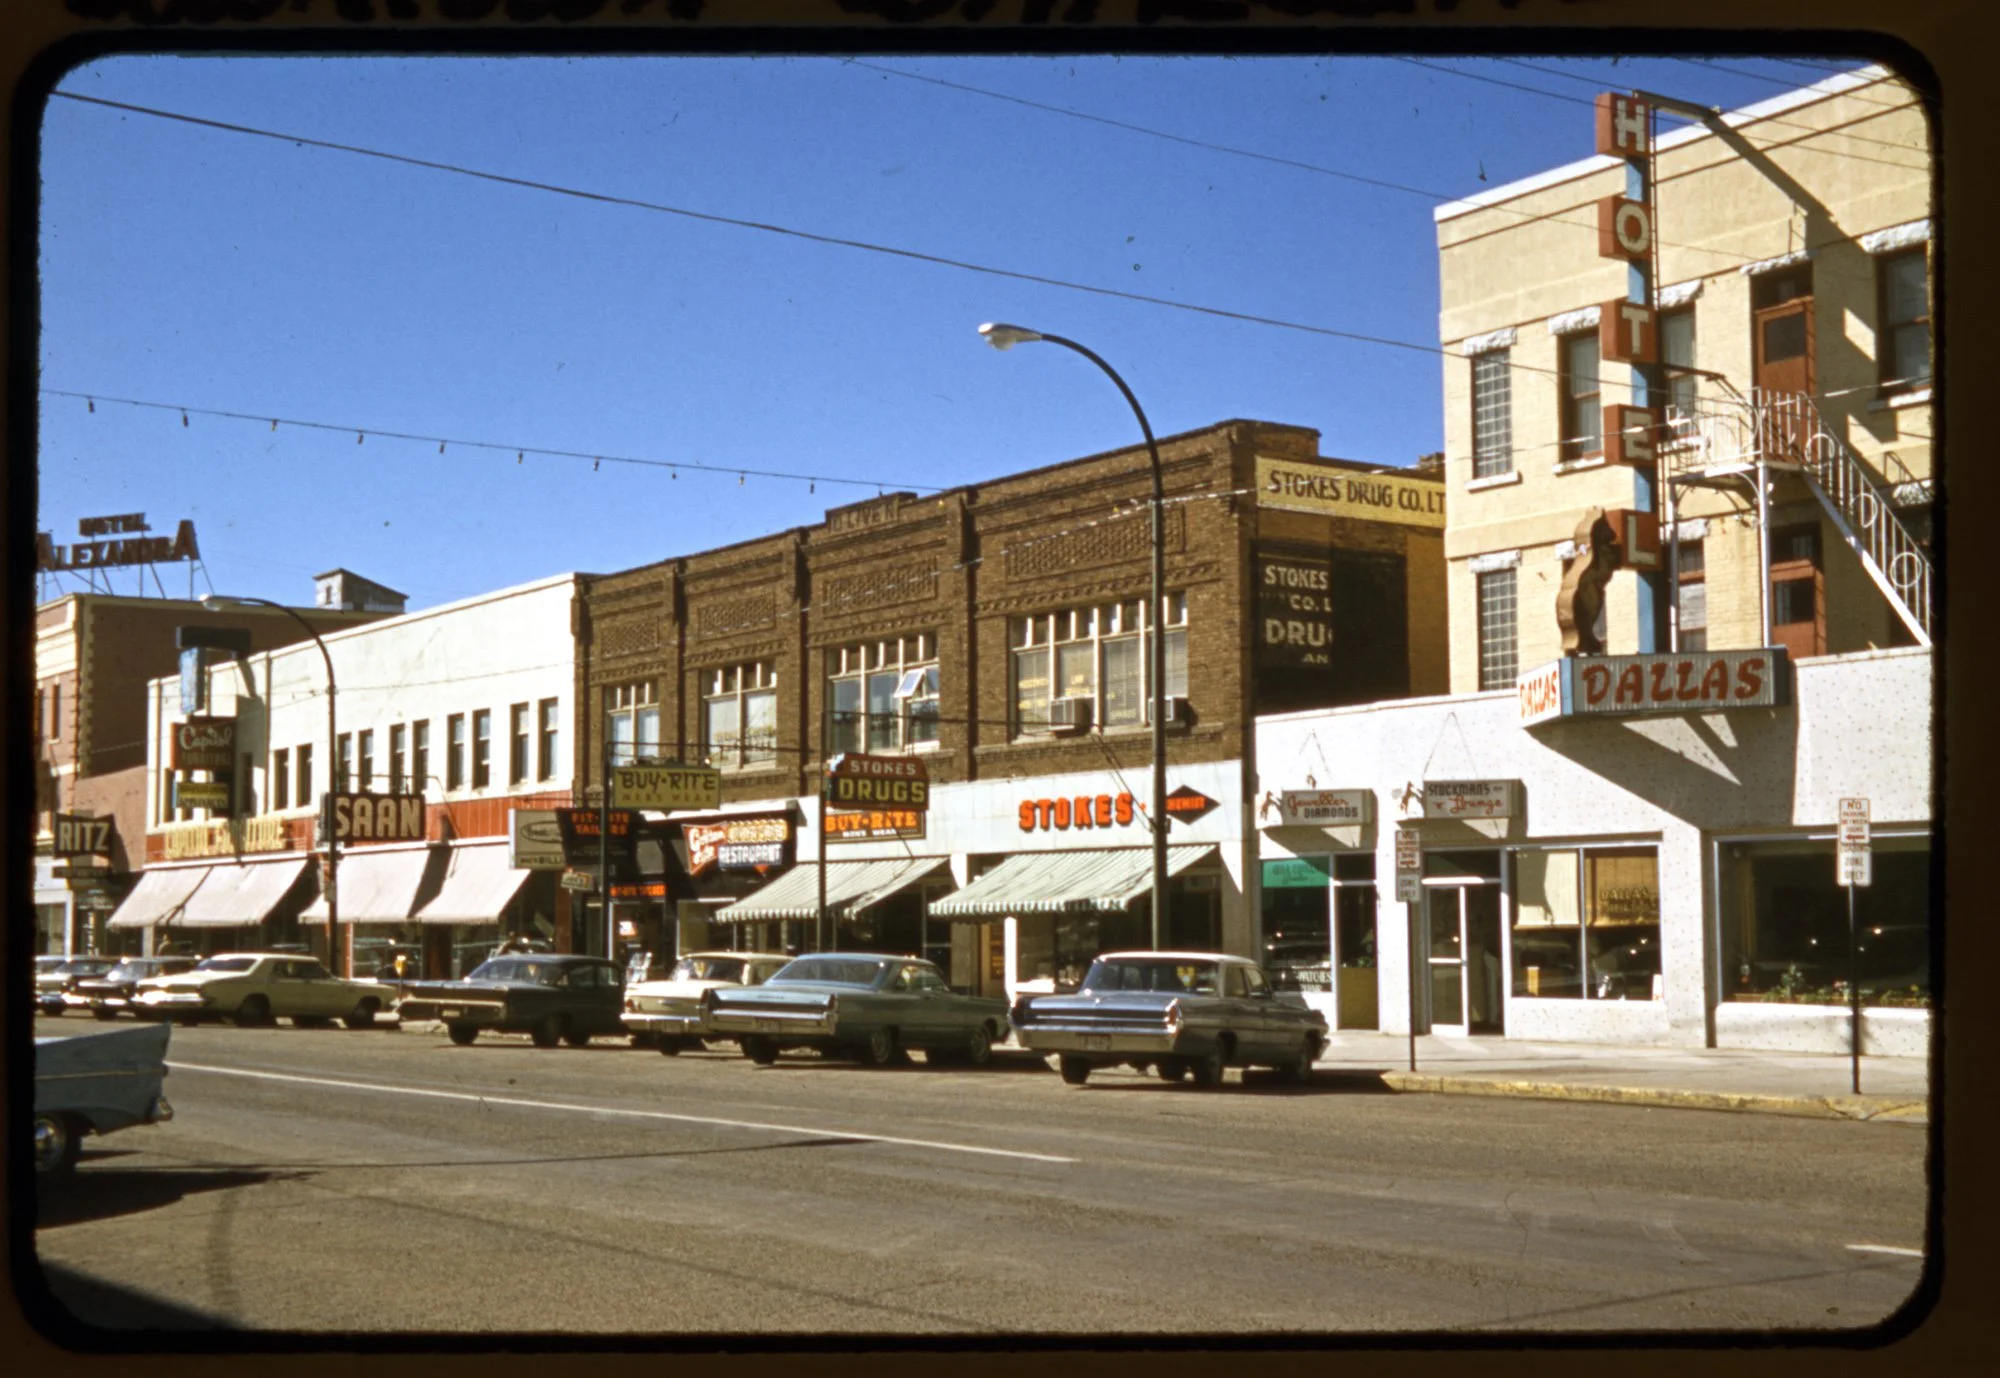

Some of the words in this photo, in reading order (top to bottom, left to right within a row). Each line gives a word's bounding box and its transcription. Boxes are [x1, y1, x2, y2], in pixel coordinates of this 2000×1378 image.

[1615, 99, 1657, 565] HOTEL
[1269, 469, 1341, 501] STOKES
[1347, 480, 1393, 508] DRUG
[1398, 488, 1424, 512] CO.
[1264, 564, 1329, 590] STOKES
[1519, 669, 1558, 719] DALLAS
[1582, 658, 1765, 705] DALLAS
[849, 759, 918, 776] STOKES
[838, 778, 927, 803] DRUGS
[335, 796, 420, 838] SAAN
[575, 824, 628, 835] TAILRS
[1018, 792, 1133, 832] STOKES
[1304, 806, 1358, 819] DIAMONDS
[58, 822, 111, 852] RITZ
